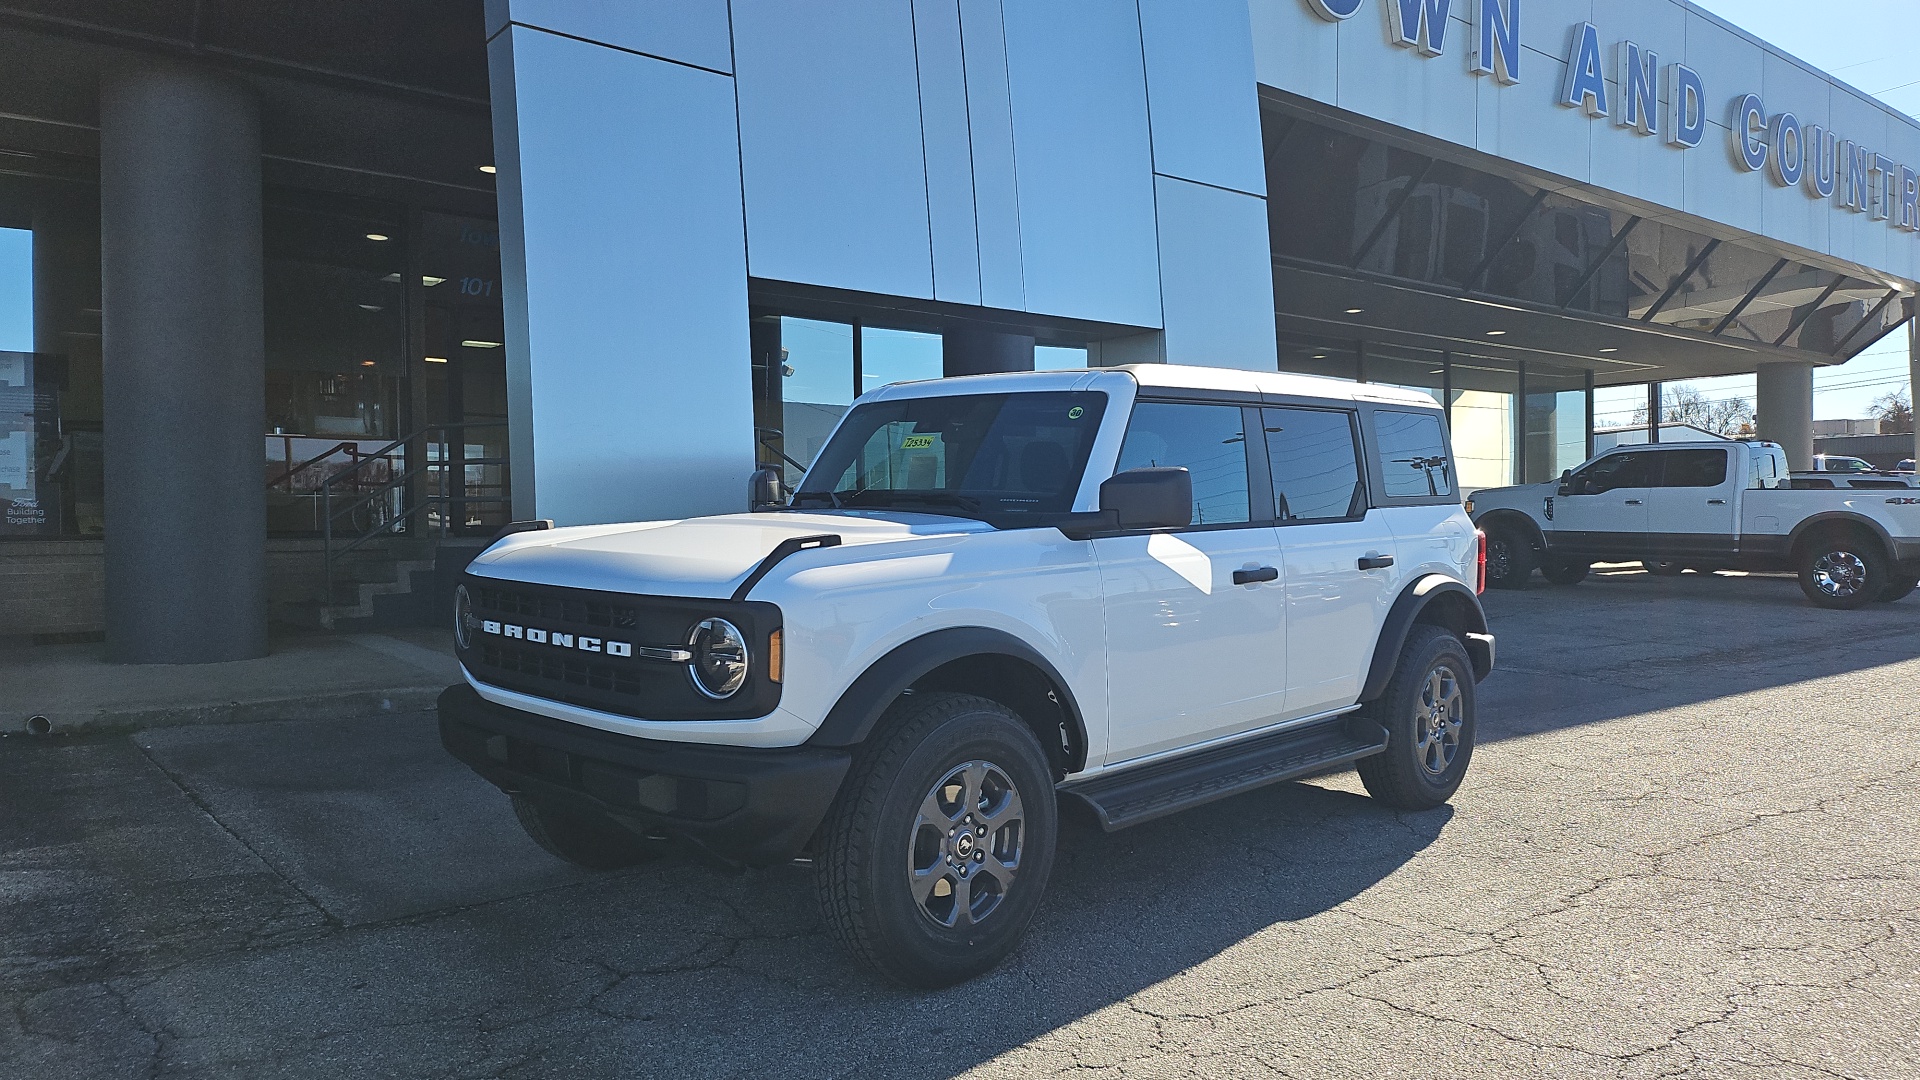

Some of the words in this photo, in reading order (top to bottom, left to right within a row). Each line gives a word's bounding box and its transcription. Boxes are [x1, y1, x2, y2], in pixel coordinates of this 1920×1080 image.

[1308, 0, 1520, 86] WN
[1561, 21, 1709, 149] AND
[1731, 93, 1920, 232] COUNTR
[11, 497, 40, 508] Ford
[7, 508, 44, 517] Building
[6, 516, 47, 525] Together
[483, 620, 632, 657] BRONCO
